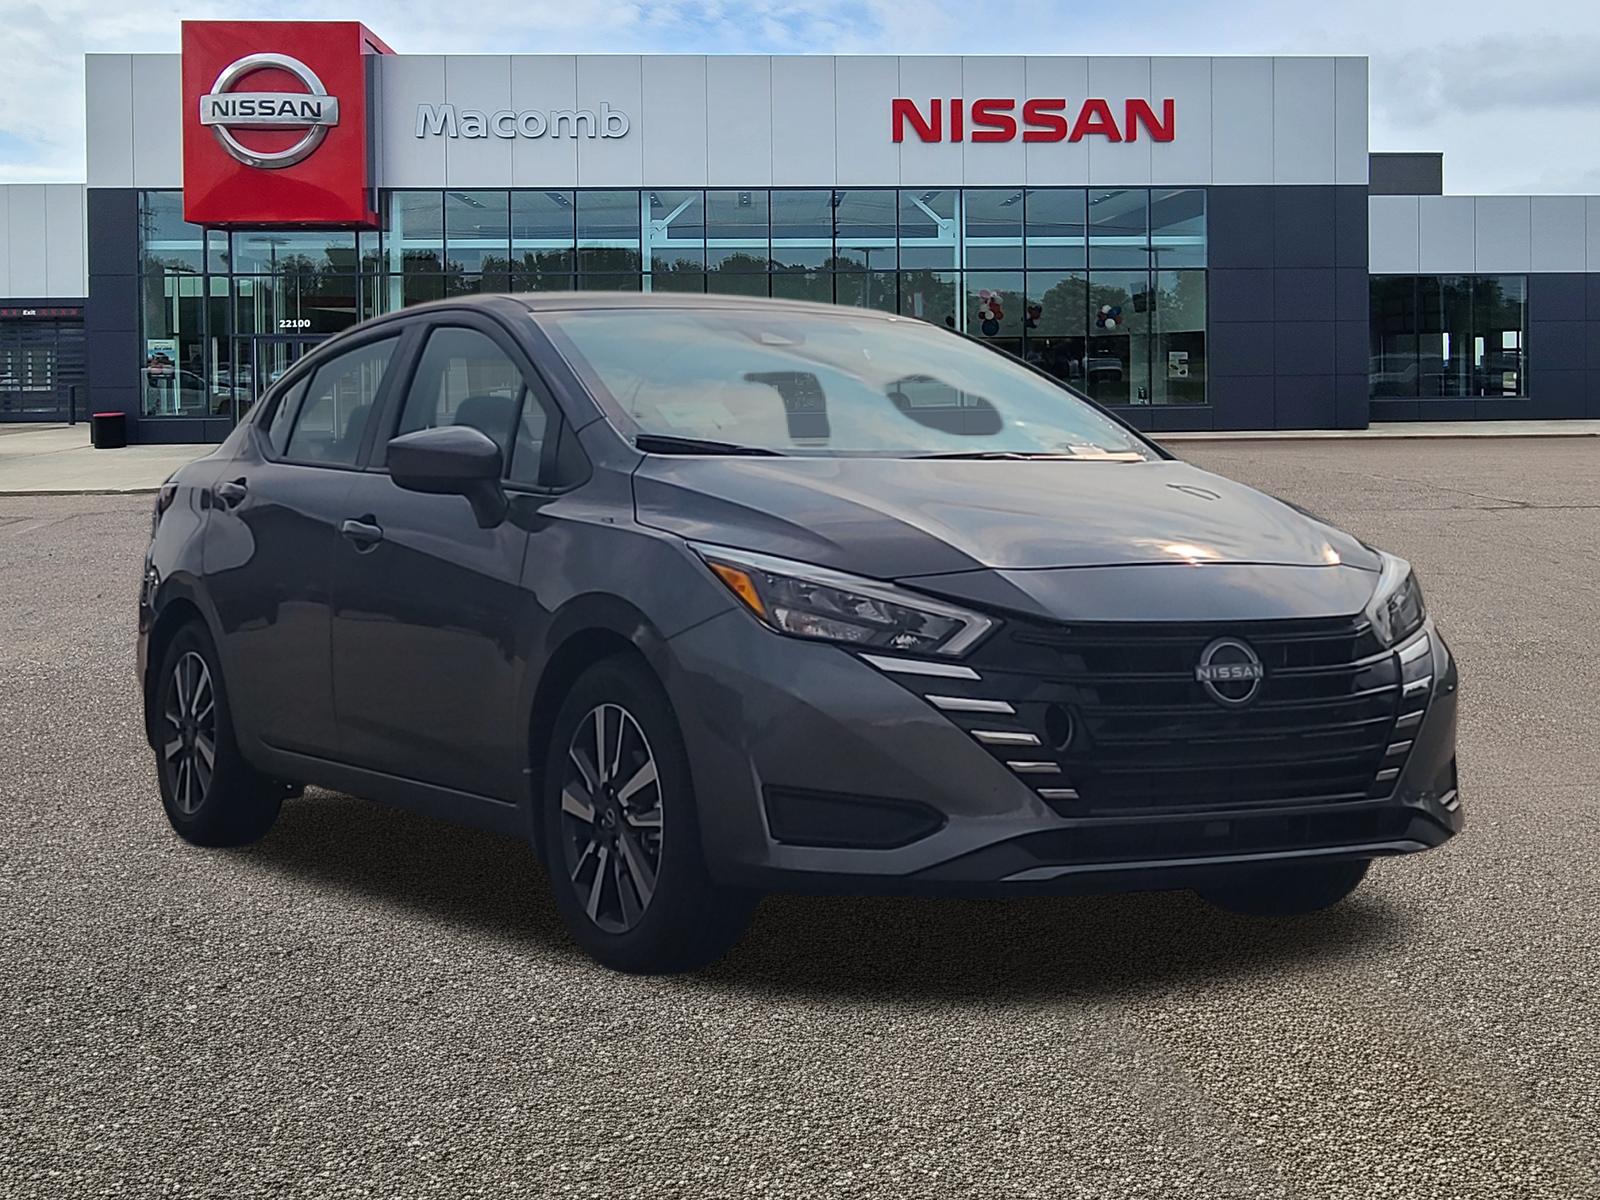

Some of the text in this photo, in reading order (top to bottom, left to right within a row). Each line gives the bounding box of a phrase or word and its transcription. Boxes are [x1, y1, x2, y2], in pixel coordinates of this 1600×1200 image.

[212, 100, 321, 118] NISSAN
[415, 101, 630, 139] Macomb
[893, 98, 1175, 142] NISSAN
[279, 319, 311, 328] 22100
[1196, 665, 1264, 681] NISSAN
